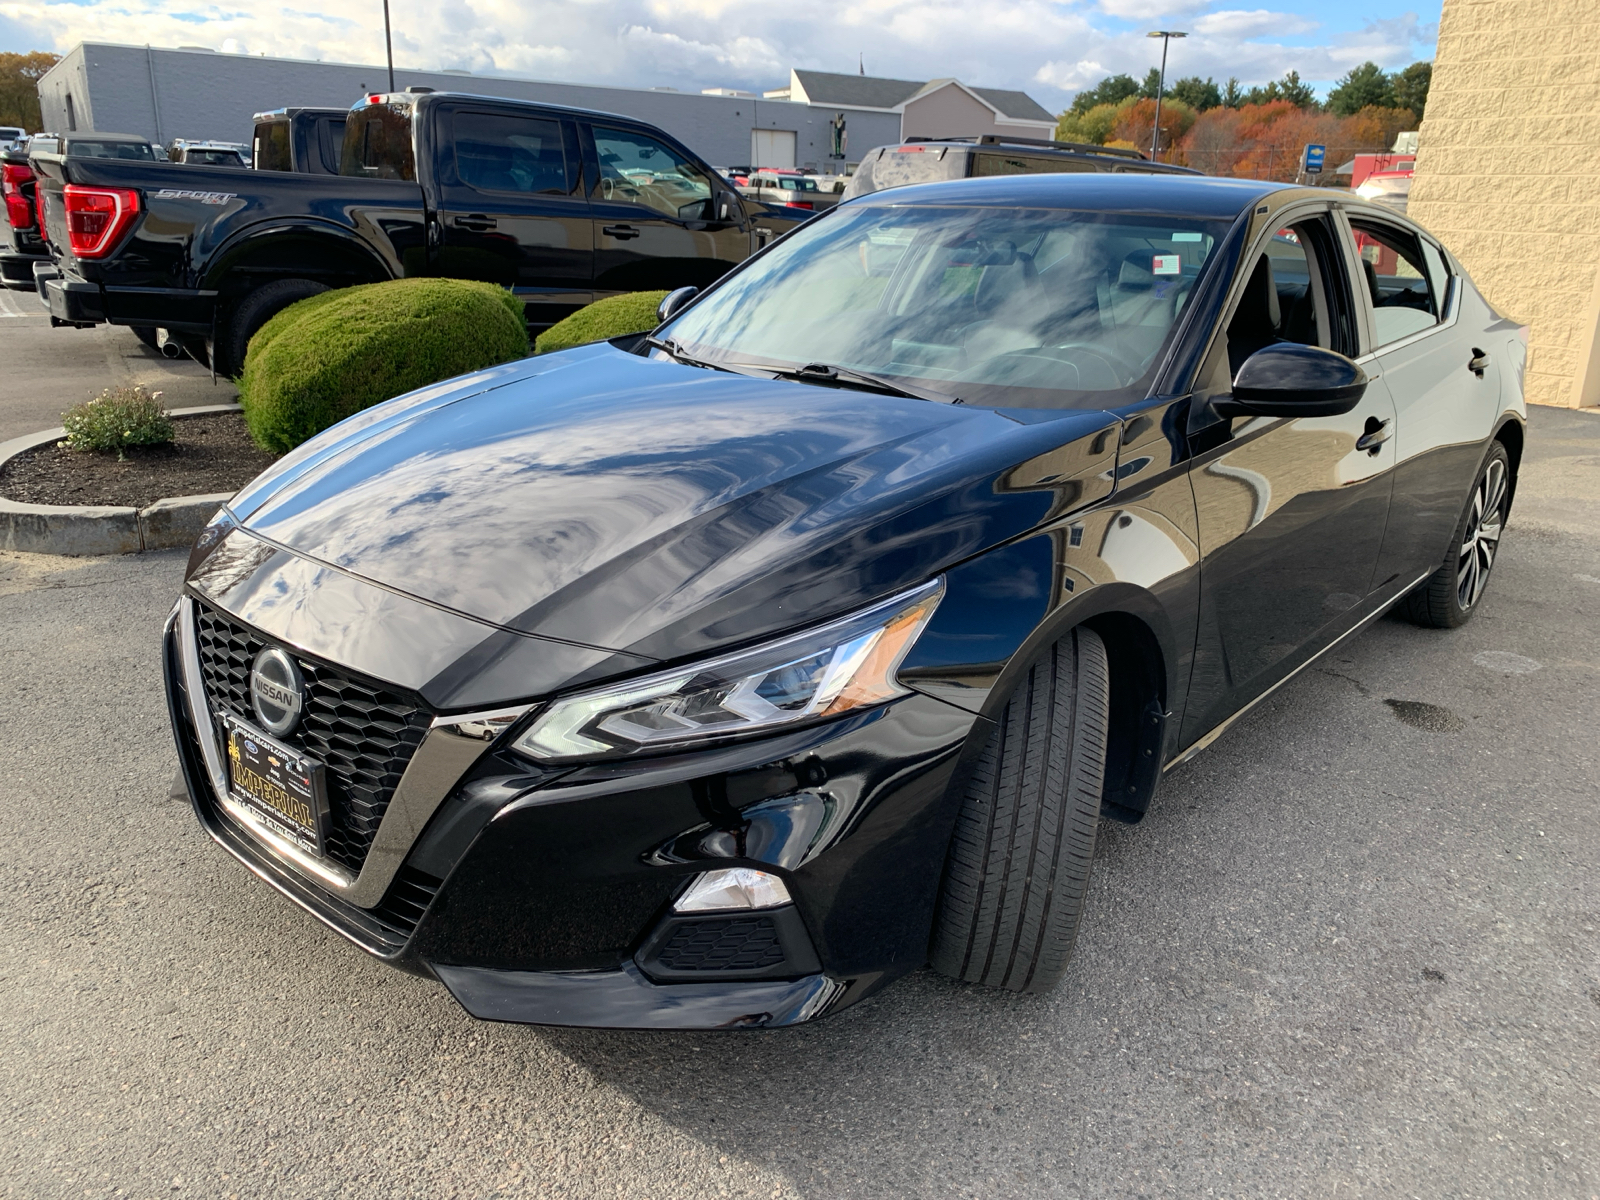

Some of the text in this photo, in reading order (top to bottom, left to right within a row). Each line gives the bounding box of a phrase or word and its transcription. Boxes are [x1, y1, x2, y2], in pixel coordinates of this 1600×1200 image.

[154, 188, 238, 200] SPORT
[254, 677, 293, 707] NISSAN
[232, 759, 316, 833] IMPERIAL
